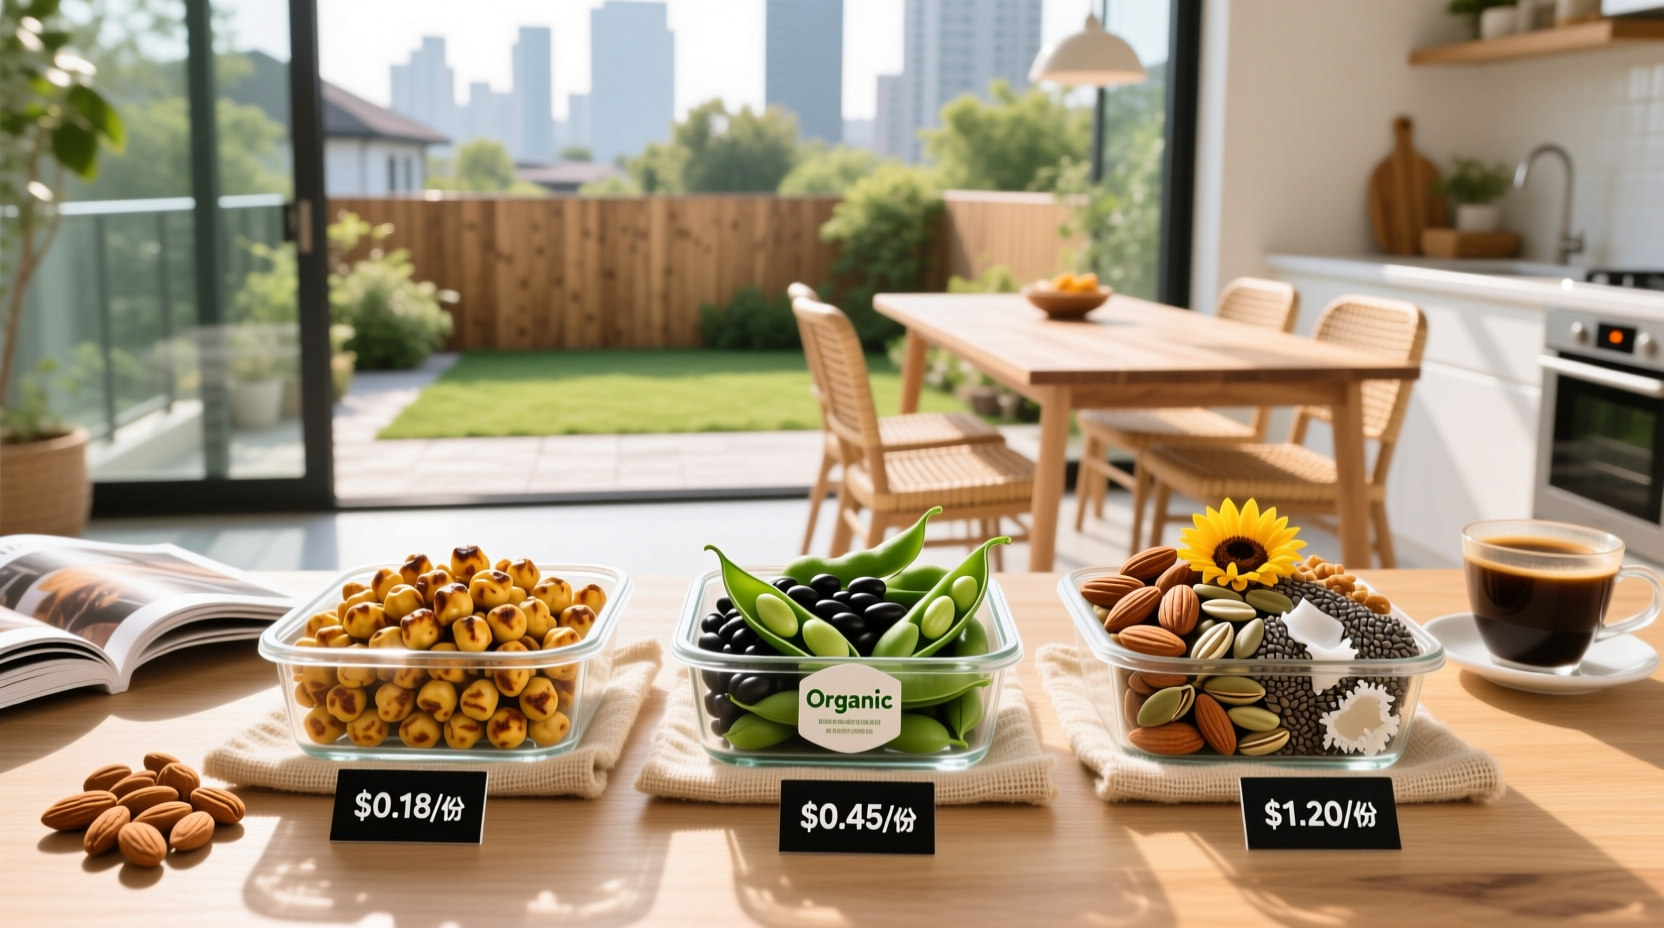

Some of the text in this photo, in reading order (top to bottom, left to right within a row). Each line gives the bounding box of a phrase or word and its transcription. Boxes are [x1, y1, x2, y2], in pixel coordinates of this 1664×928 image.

[806, 688, 893, 714] Organic
[354, 788, 465, 823] $0.18/份
[800, 800, 917, 833] $0.45/份
[1264, 798, 1377, 831] $1.20/份
